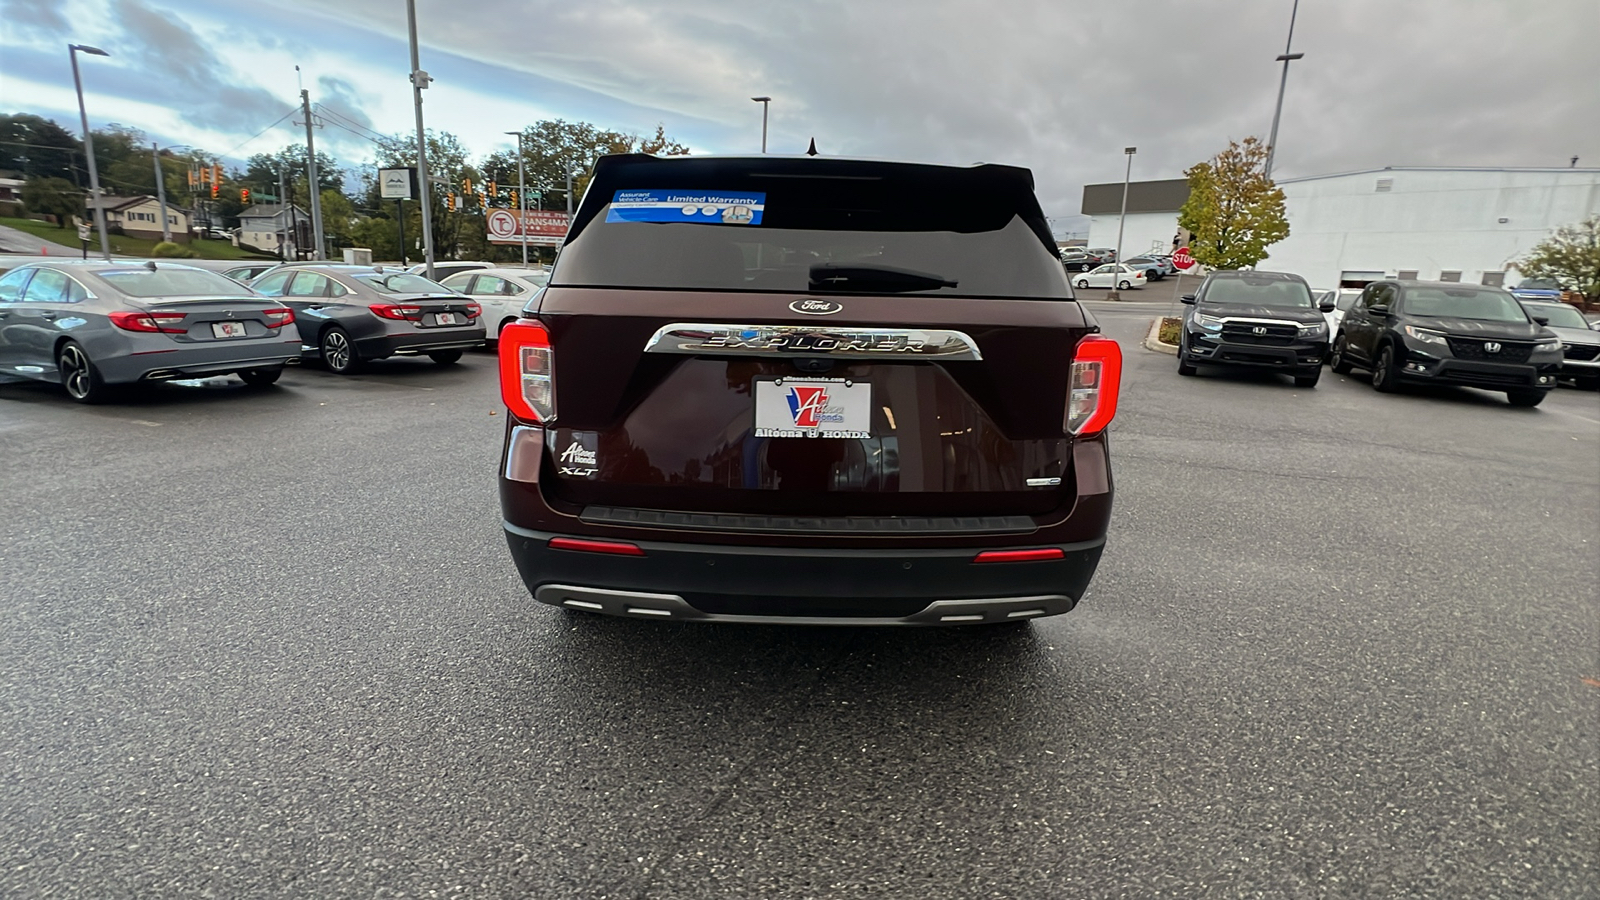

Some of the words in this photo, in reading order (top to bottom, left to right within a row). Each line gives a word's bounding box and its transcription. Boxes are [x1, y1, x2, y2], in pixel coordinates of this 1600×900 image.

[666, 195, 706, 203] Limited
[707, 196, 758, 205] Warranty
[517, 217, 569, 227] TRANS4MA
[801, 299, 831, 310] Ford
[701, 335, 924, 352] EXPLORER
[754, 428, 803, 438] Altoona
[822, 430, 871, 439] HONDA
[558, 467, 599, 476] XLT
